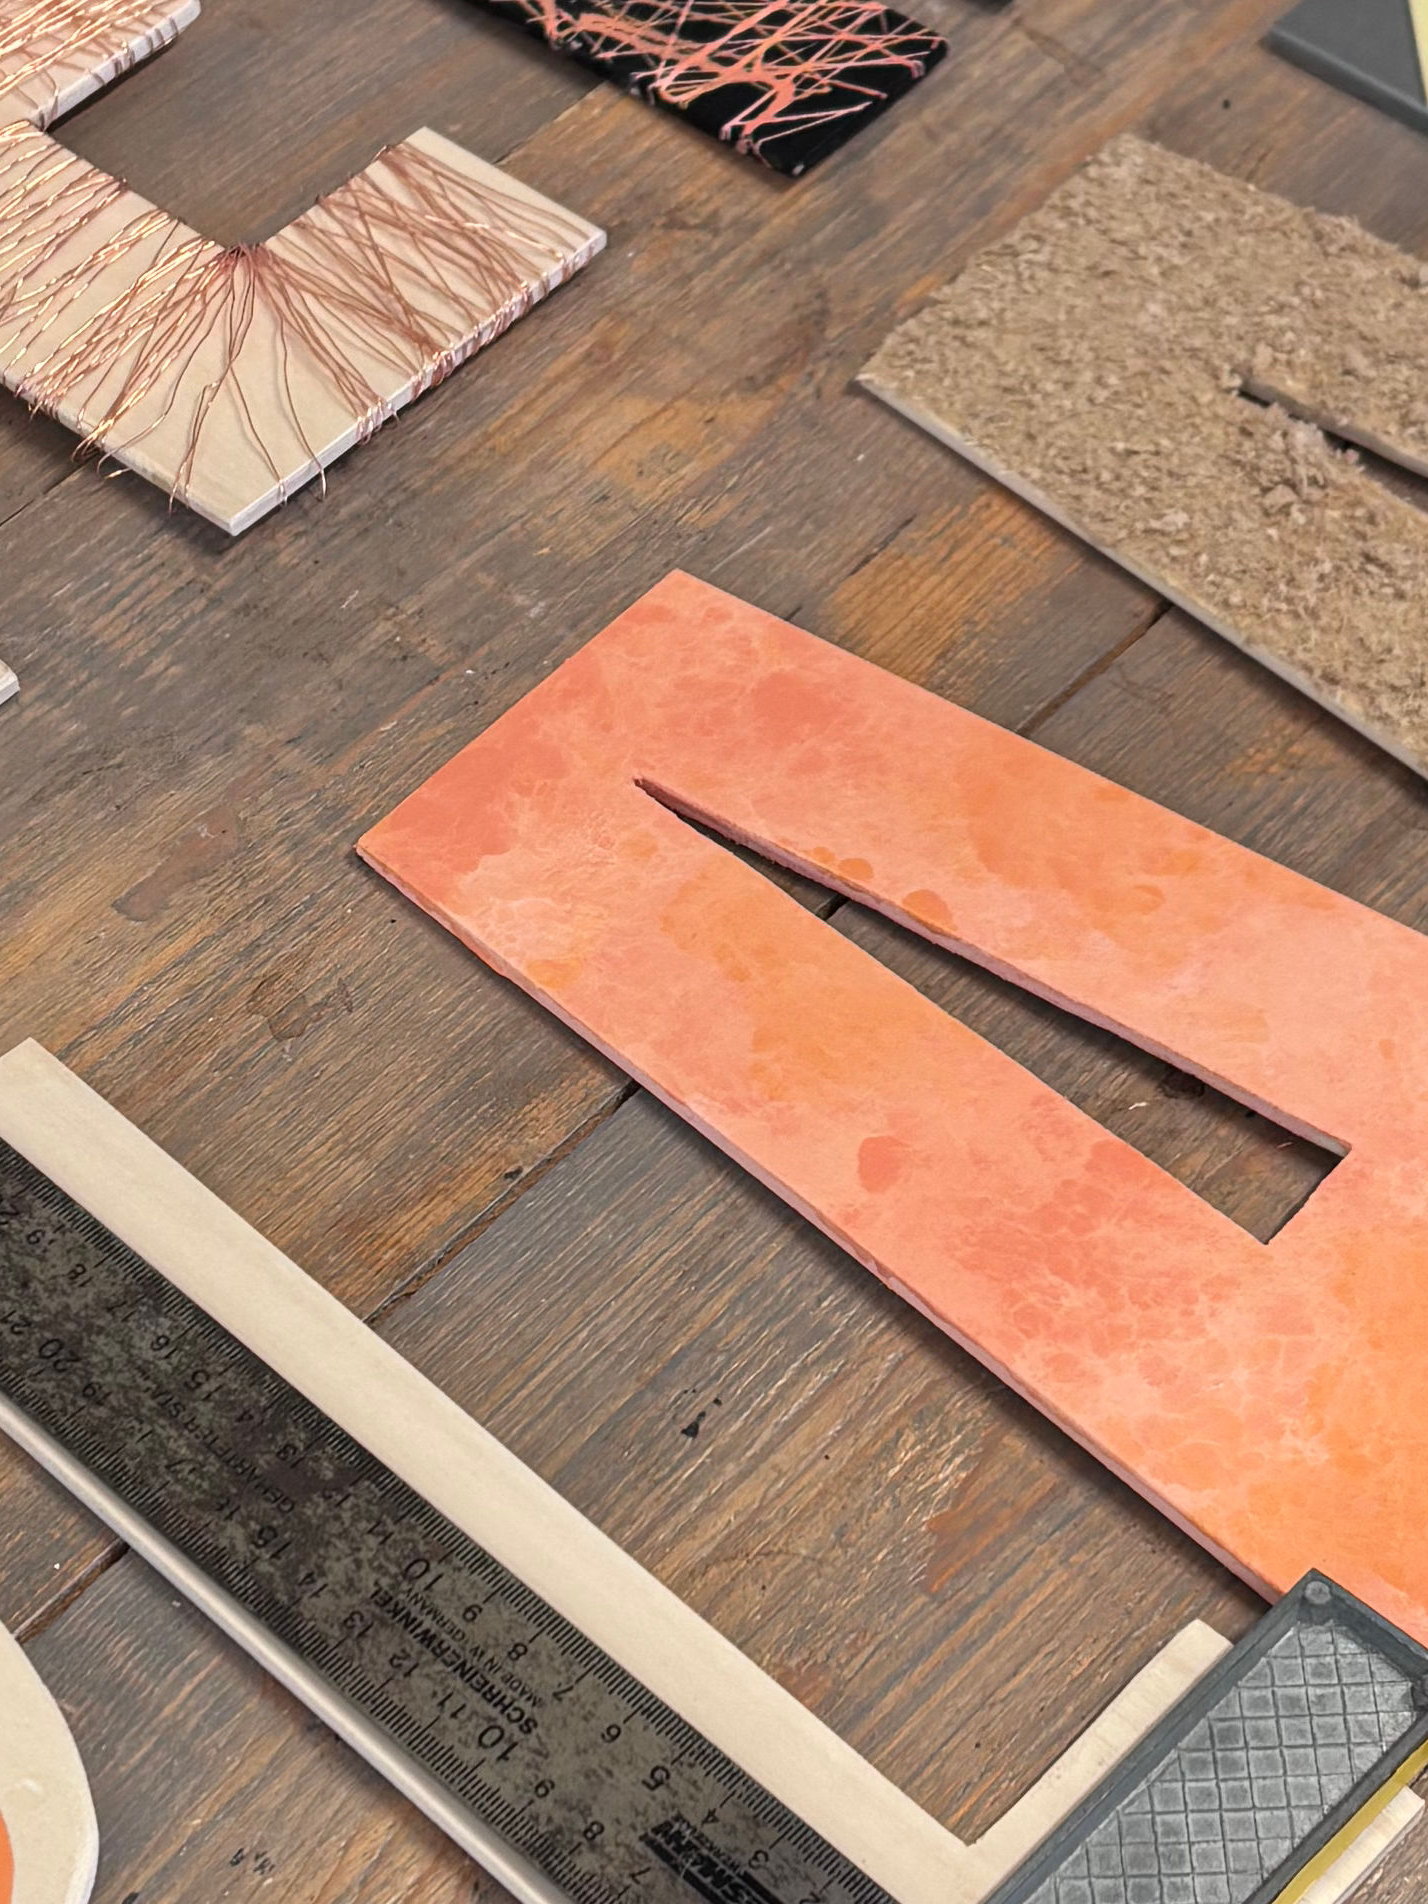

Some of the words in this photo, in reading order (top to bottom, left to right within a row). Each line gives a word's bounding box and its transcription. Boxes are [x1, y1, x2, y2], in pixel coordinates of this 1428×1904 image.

[38, 1335, 78, 1374] 20
[150, 1332, 179, 1360] 16
[184, 1366, 221, 1402] 15
[403, 1554, 443, 1594] 10
[365, 1579, 537, 1737] SCHREINERWINKEL
[388, 1647, 418, 1677] 12
[477, 1722, 518, 1762] 10
